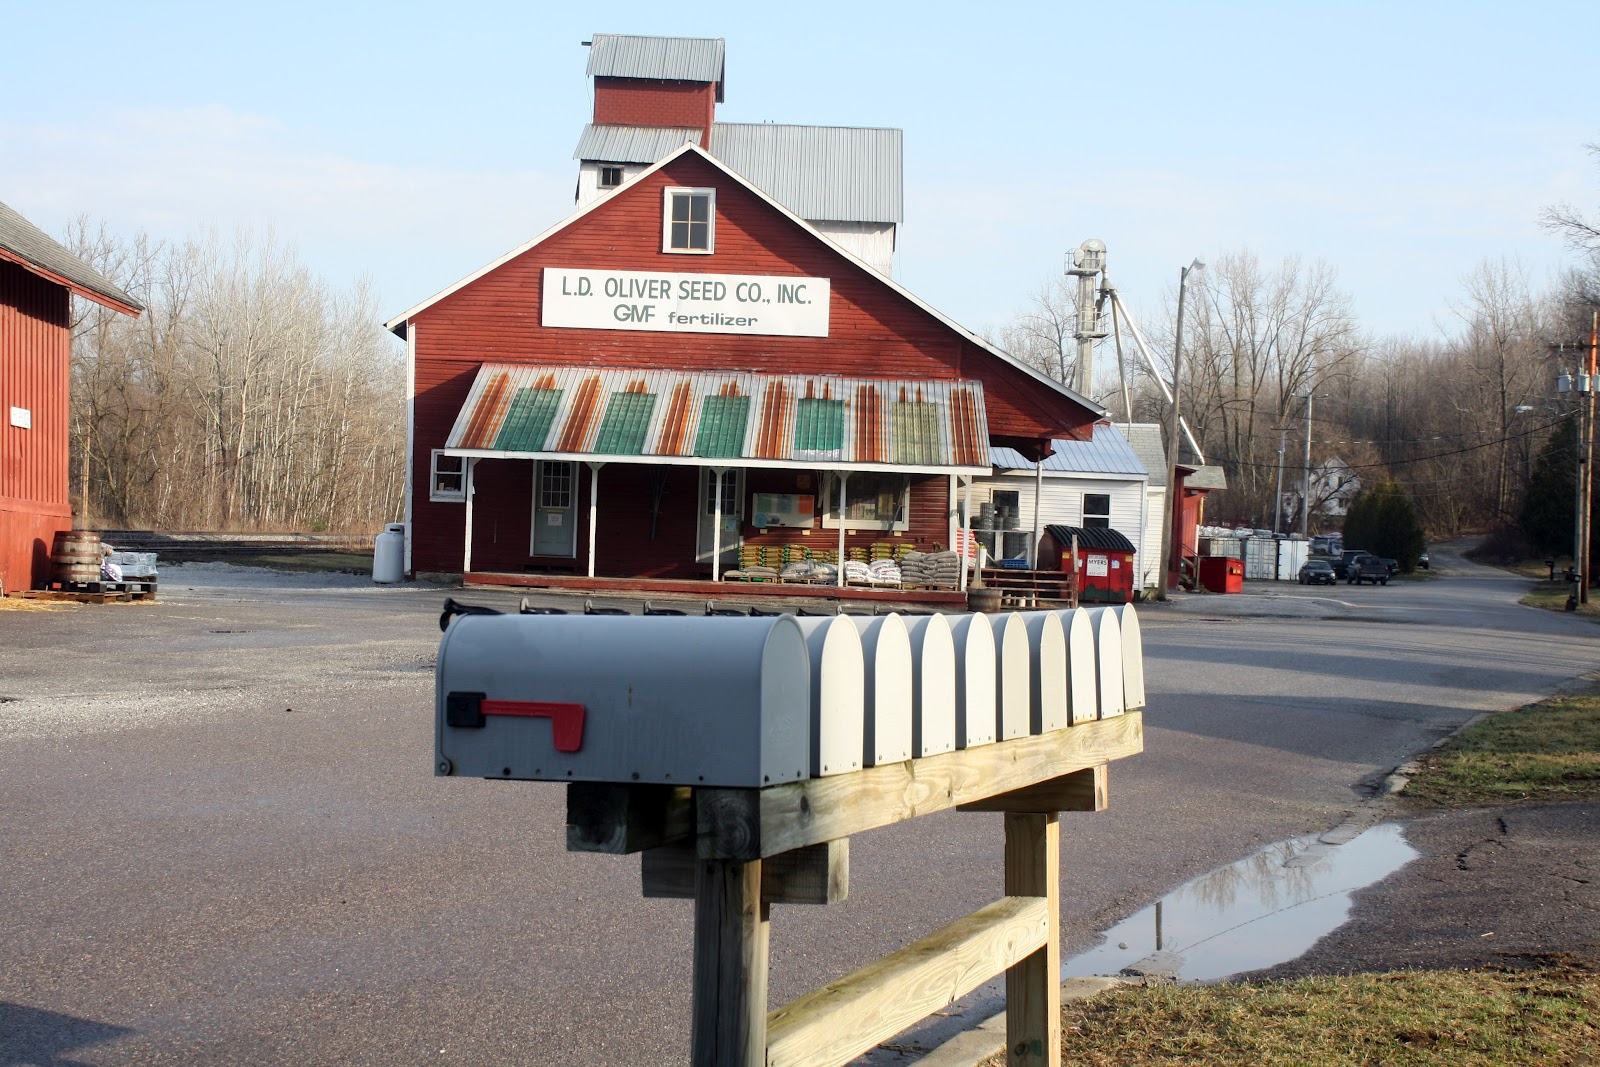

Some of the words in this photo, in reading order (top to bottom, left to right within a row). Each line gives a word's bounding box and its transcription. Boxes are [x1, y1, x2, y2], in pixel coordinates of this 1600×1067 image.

[562, 275, 593, 297] L.D.
[604, 277, 672, 300] OLIVER
[678, 279, 727, 302] SEED
[735, 282, 771, 305] CO.,
[777, 283, 812, 305] INC.
[613, 304, 656, 323] GMF
[667, 311, 759, 327] fertilizer
